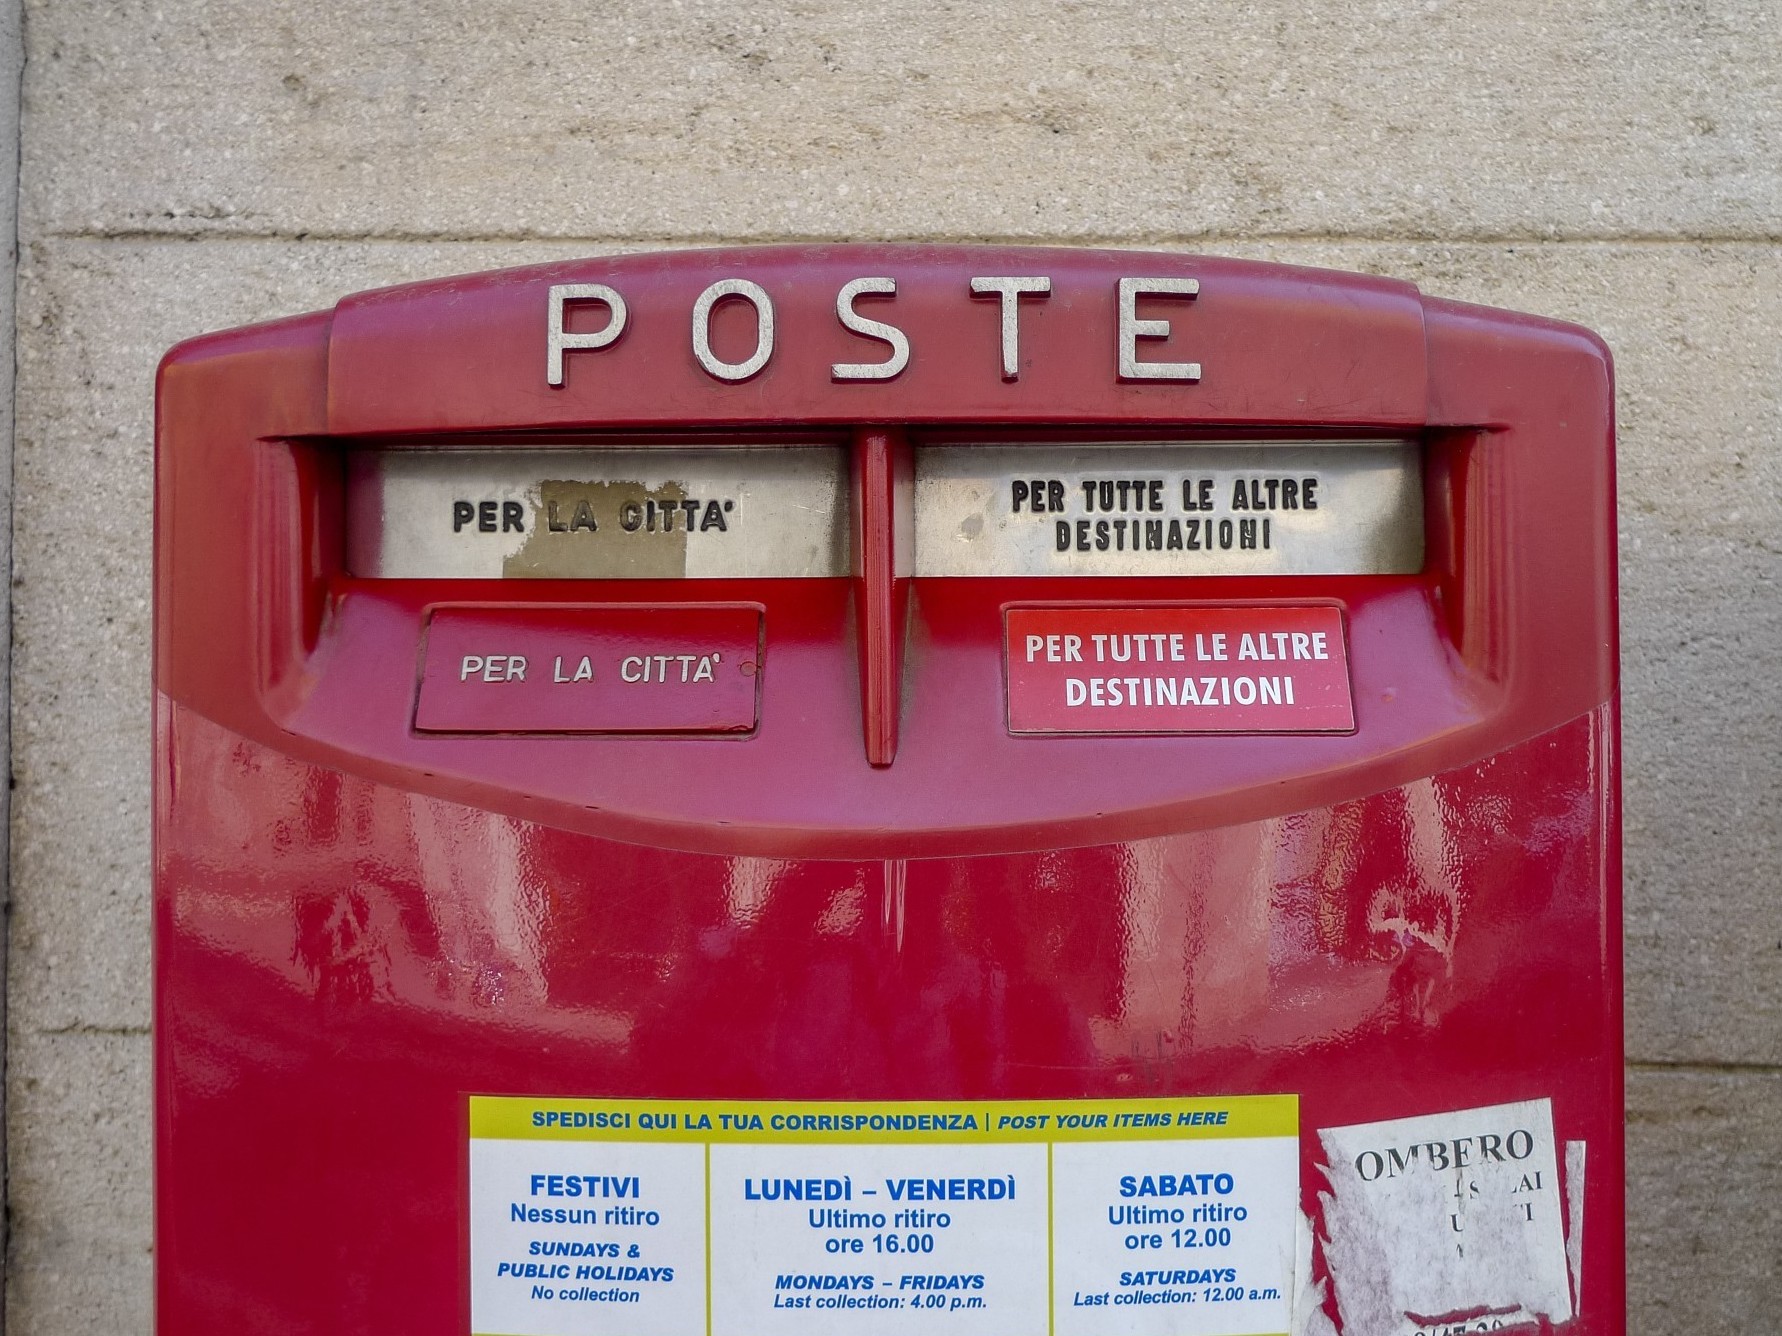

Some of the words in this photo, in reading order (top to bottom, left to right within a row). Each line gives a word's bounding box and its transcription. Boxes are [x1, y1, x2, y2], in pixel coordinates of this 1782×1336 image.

[546, 276, 1201, 389] POSTE
[1011, 479, 1065, 512] PER
[1082, 479, 1164, 512] TUTTE
[1182, 479, 1214, 511] LE
[1231, 478, 1317, 510] ALTRE
[452, 500, 524, 533] PER
[547, 500, 597, 533] LA
[1056, 518, 1271, 551] DESTINAZIONI
[1025, 634, 1083, 662] PER
[1091, 634, 1186, 662] TUTTE
[1196, 633, 1228, 661] LE
[1238, 632, 1329, 661] ALTRE
[460, 655, 526, 683] PER
[554, 656, 594, 683] LA
[1065, 676, 1295, 707] DESTINAZIONI
[532, 1111, 631, 1129] SPEDISCI
[638, 1113, 677, 1130] QUI
[684, 1114, 712, 1130] LA
[719, 1114, 762, 1130] TUA
[770, 1114, 978, 1131] CORRISPONDENZA
[998, 1115, 1050, 1130] POST
[1056, 1114, 1108, 1128] YOUR
[1113, 1113, 1171, 1127] ITEMS
[1176, 1112, 1228, 1126] HERE
[530, 1174, 640, 1198] FESTIVI
[744, 1175, 852, 1201] LUNEDÌ
[886, 1175, 1016, 1201] VENERDÌ
[1119, 1173, 1234, 1197] SABATO
[511, 1203, 596, 1224] Nessun
[605, 1205, 660, 1226] ritiro
[808, 1208, 886, 1229] Ultimo
[894, 1208, 951, 1229] ritiro
[1108, 1204, 1185, 1225] Ultimo
[1192, 1202, 1247, 1222] ritiro
[528, 1241, 620, 1258] SUNDAYS
[627, 1243, 640, 1258] &
[825, 1238, 863, 1254] ore
[872, 1234, 934, 1253] 16.00
[1124, 1231, 1163, 1249] ore
[1171, 1228, 1231, 1248] 12.00
[497, 1263, 570, 1279] PUBLIC
[575, 1265, 674, 1282] HOLIDAYS
[775, 1275, 874, 1290] MONDAYS
[899, 1275, 985, 1290] FRIDAYS
[1119, 1269, 1236, 1286] SATURDAYS
[531, 1285, 554, 1300] No
[559, 1287, 640, 1302] collection
[774, 1293, 811, 1309] Last
[816, 1293, 905, 1309] collection:
[911, 1294, 946, 1308] 4.00
[950, 1295, 987, 1312] p.m.
[1073, 1292, 1109, 1307] Last
[1114, 1289, 1196, 1305] collection:
[1203, 1288, 1244, 1302] 12.00
[1249, 1288, 1281, 1301] a.m.
